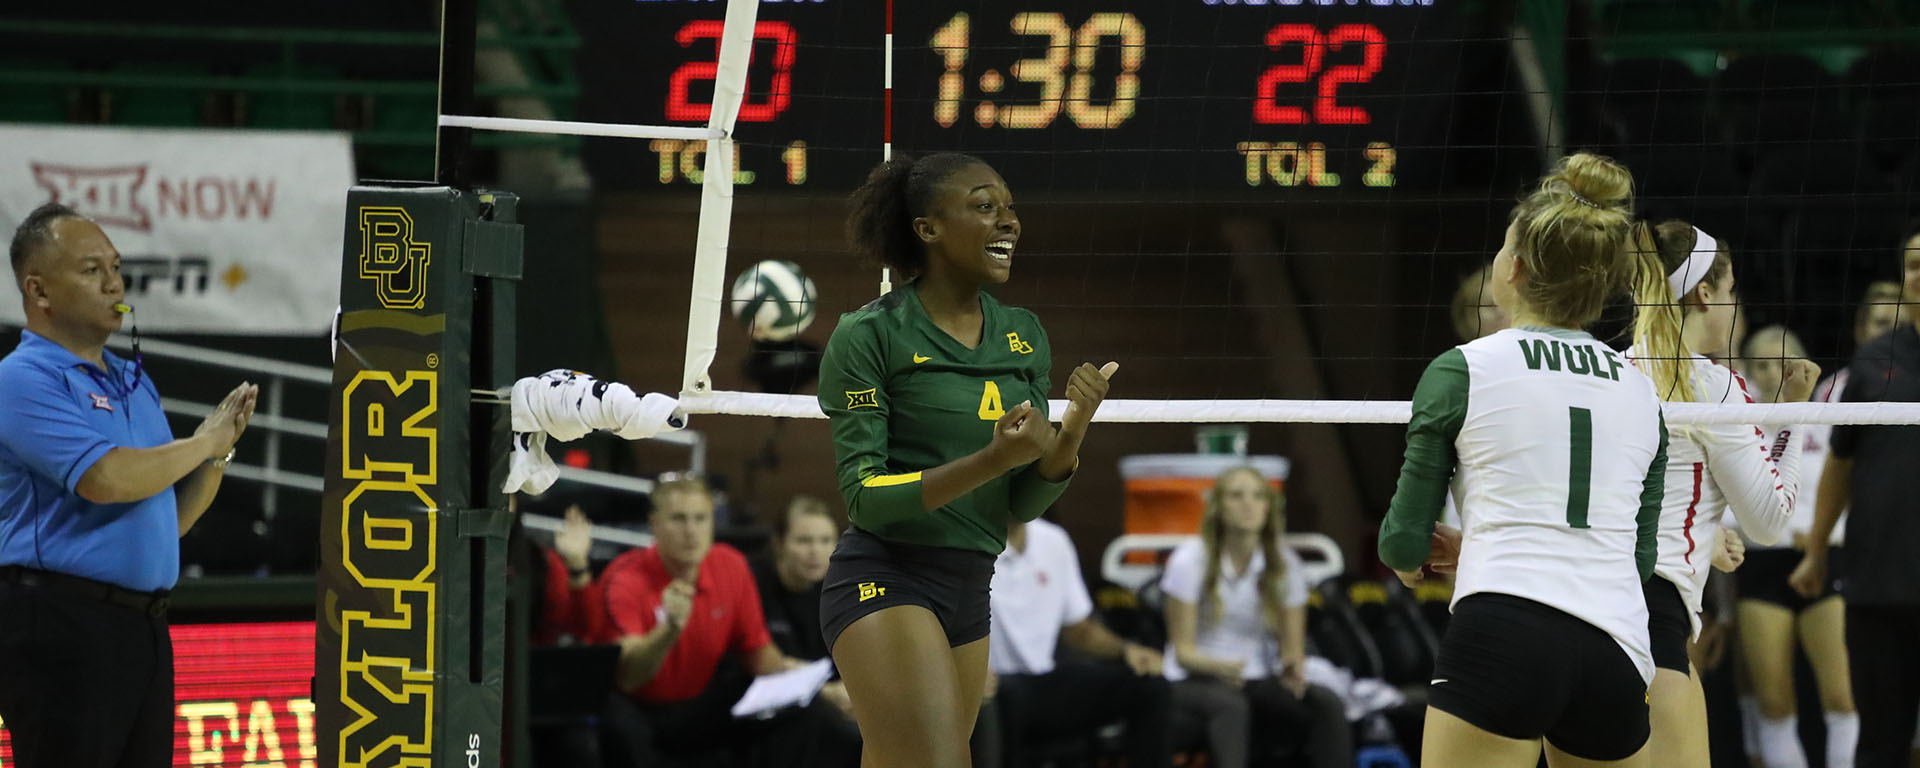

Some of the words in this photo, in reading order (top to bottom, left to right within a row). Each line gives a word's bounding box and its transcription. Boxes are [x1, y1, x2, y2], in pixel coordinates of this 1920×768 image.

[665, 20, 798, 121] 20
[929, 12, 1146, 129] 1:30
[1253, 23, 1388, 124] 22
[158, 176, 277, 220] NOW
[782, 139, 808, 185] 1
[1237, 141, 1341, 186] TOL
[1362, 141, 1397, 187] 2
[359, 206, 431, 309] BU
[978, 380, 1006, 433] 4
[1517, 338, 1625, 383] WULF
[1566, 406, 1592, 529] 1
[338, 370, 438, 768] YLOR
